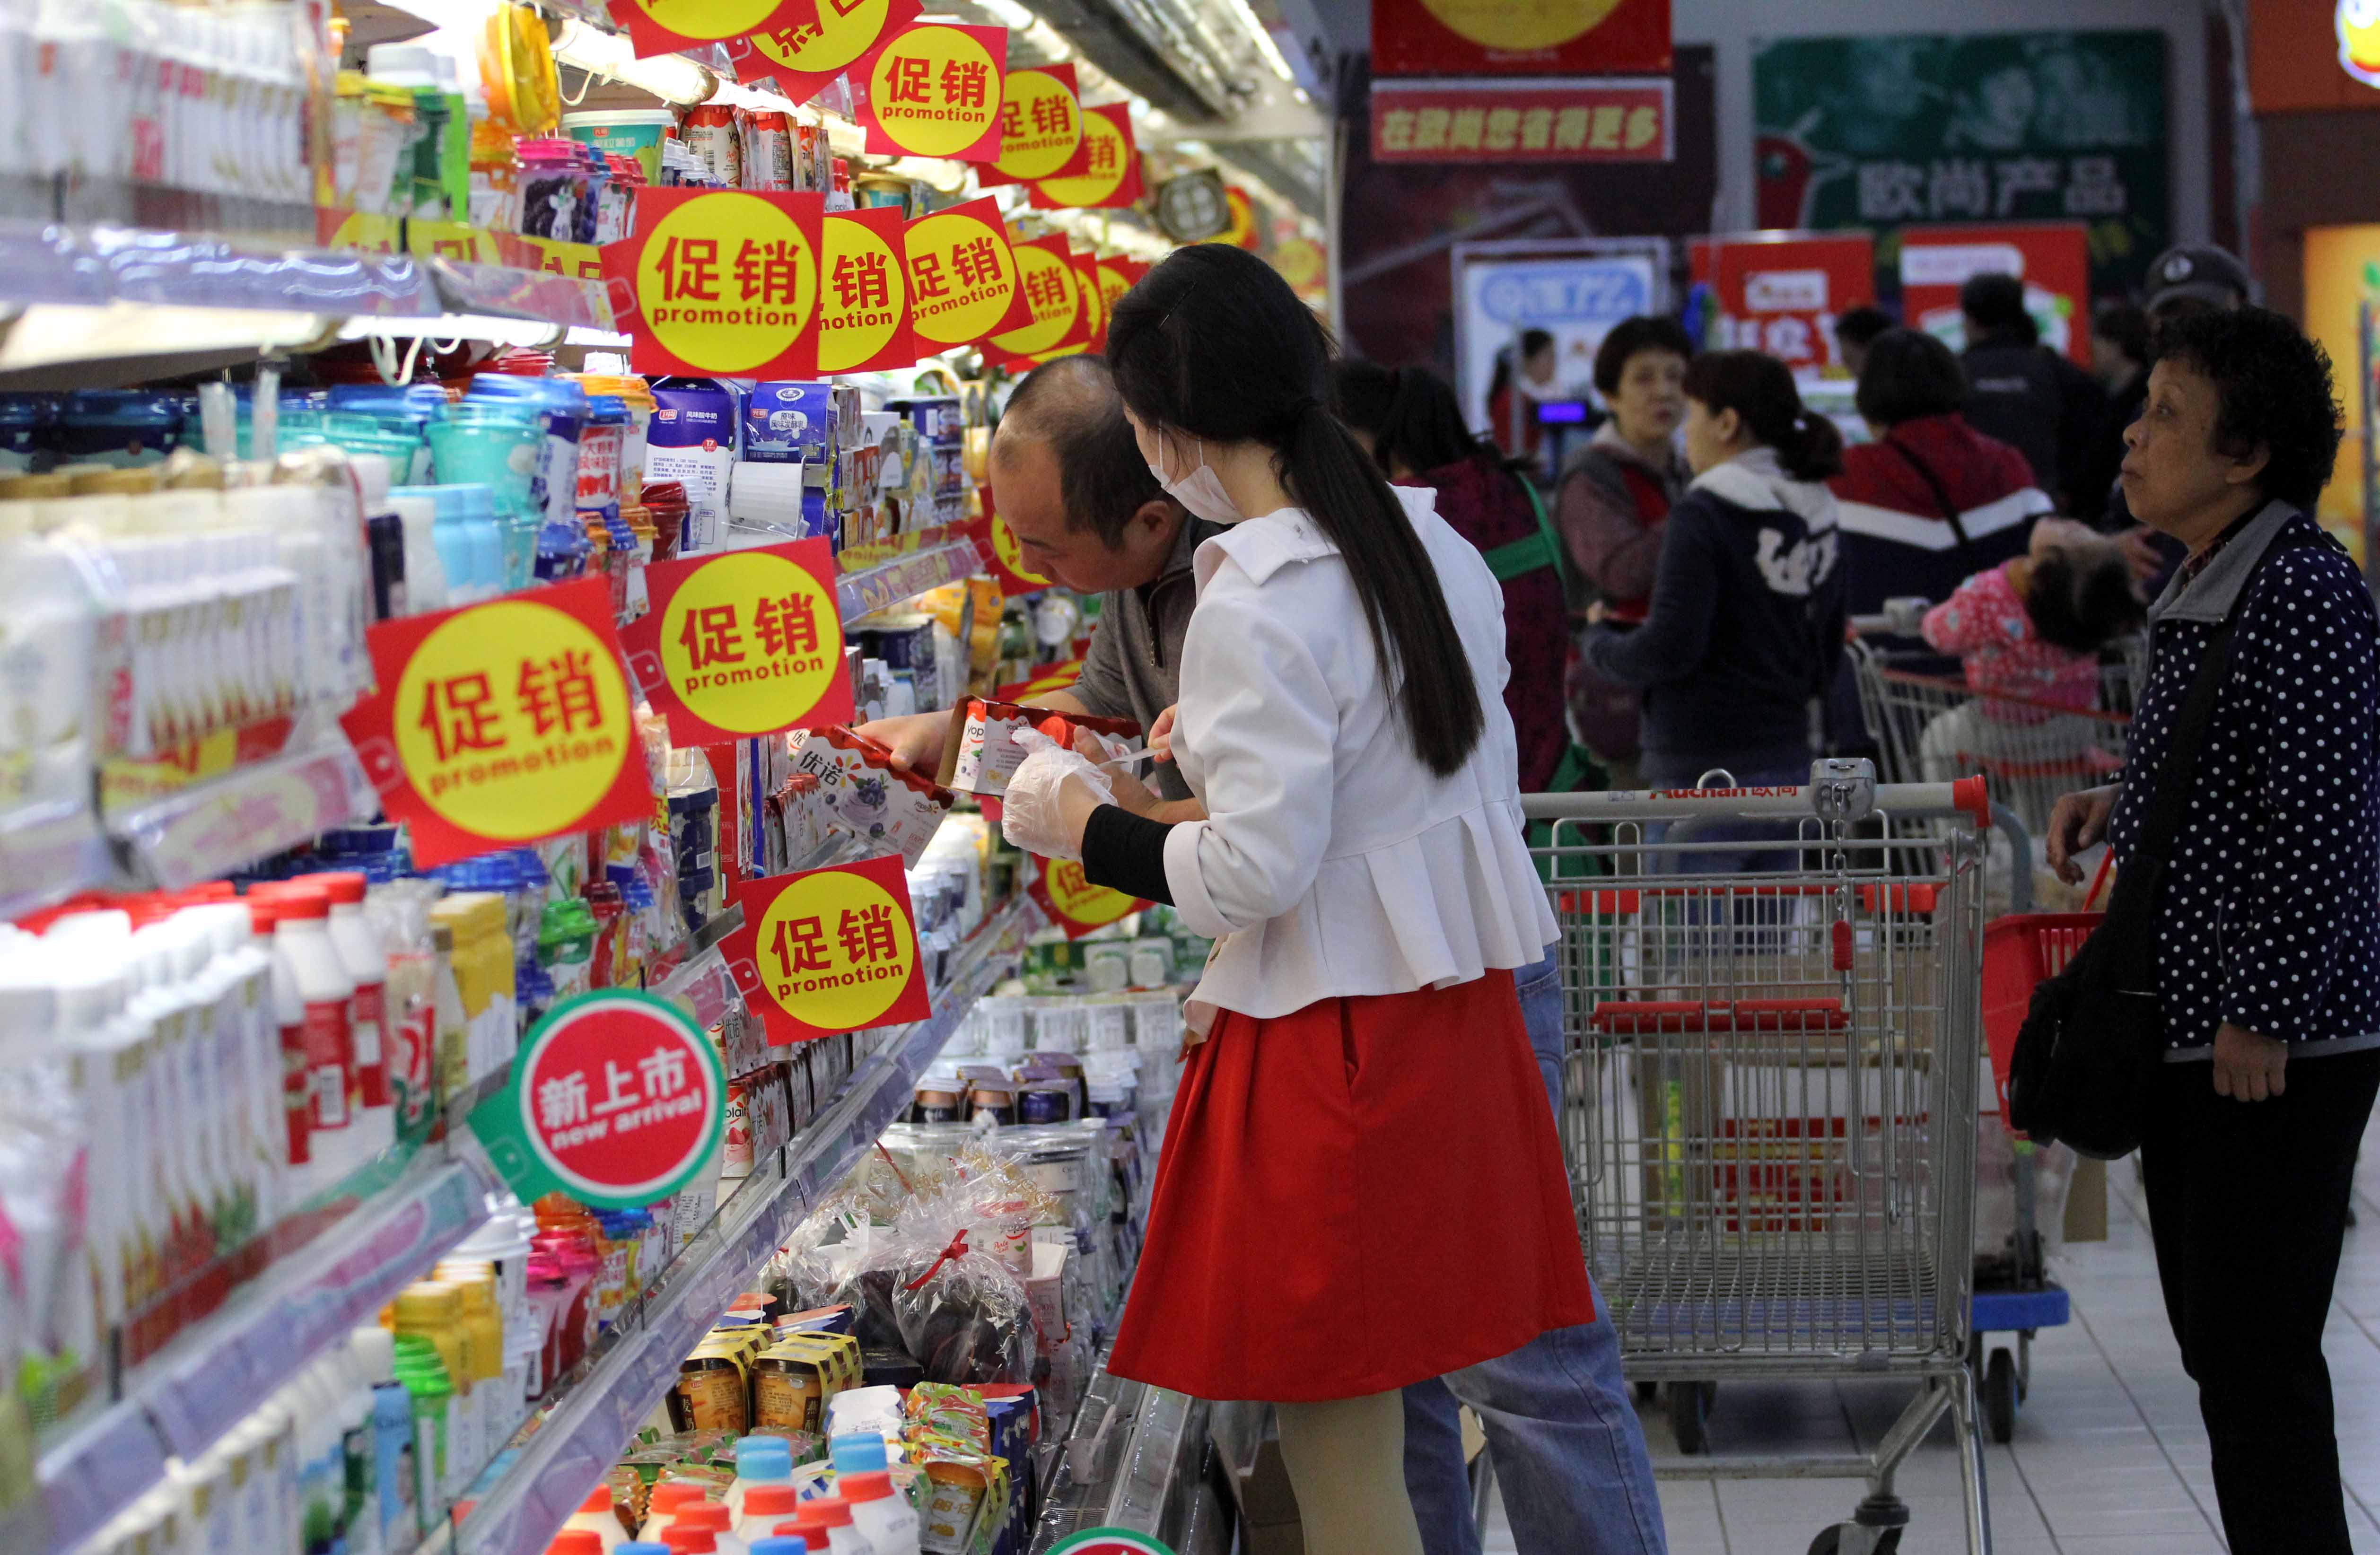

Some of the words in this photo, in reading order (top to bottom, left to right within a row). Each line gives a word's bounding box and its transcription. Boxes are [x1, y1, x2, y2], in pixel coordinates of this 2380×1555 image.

[885, 56, 989, 109] 促销
[882, 107, 985, 124] promotion
[1006, 136, 1074, 153] omotion
[1087, 134, 1116, 169] 销
[1857, 157, 2127, 221] 欧尚产品
[656, 236, 799, 306] 促销
[831, 252, 889, 309] 销
[908, 237, 1003, 306] 促销
[1027, 266, 1067, 307] 销
[654, 308, 797, 326] promotion
[819, 312, 893, 331] motion
[912, 283, 1009, 325] promotion
[771, 420, 804, 428] 风味发酵乳
[679, 593, 819, 670] 促销
[685, 657, 823, 695] promotion
[420, 650, 603, 762] 促销
[792, 730, 807, 747] 优
[429, 738, 614, 796] promotion
[799, 750, 844, 786] 优诺
[1649, 787, 1746, 800] Auchan
[1057, 861, 1098, 899] 促
[770, 903, 898, 978] 促销
[778, 963, 903, 1001] promotion
[539, 1046, 687, 1129] 新上市
[551, 1118, 609, 1151] new
[614, 1087, 703, 1133] arrival
